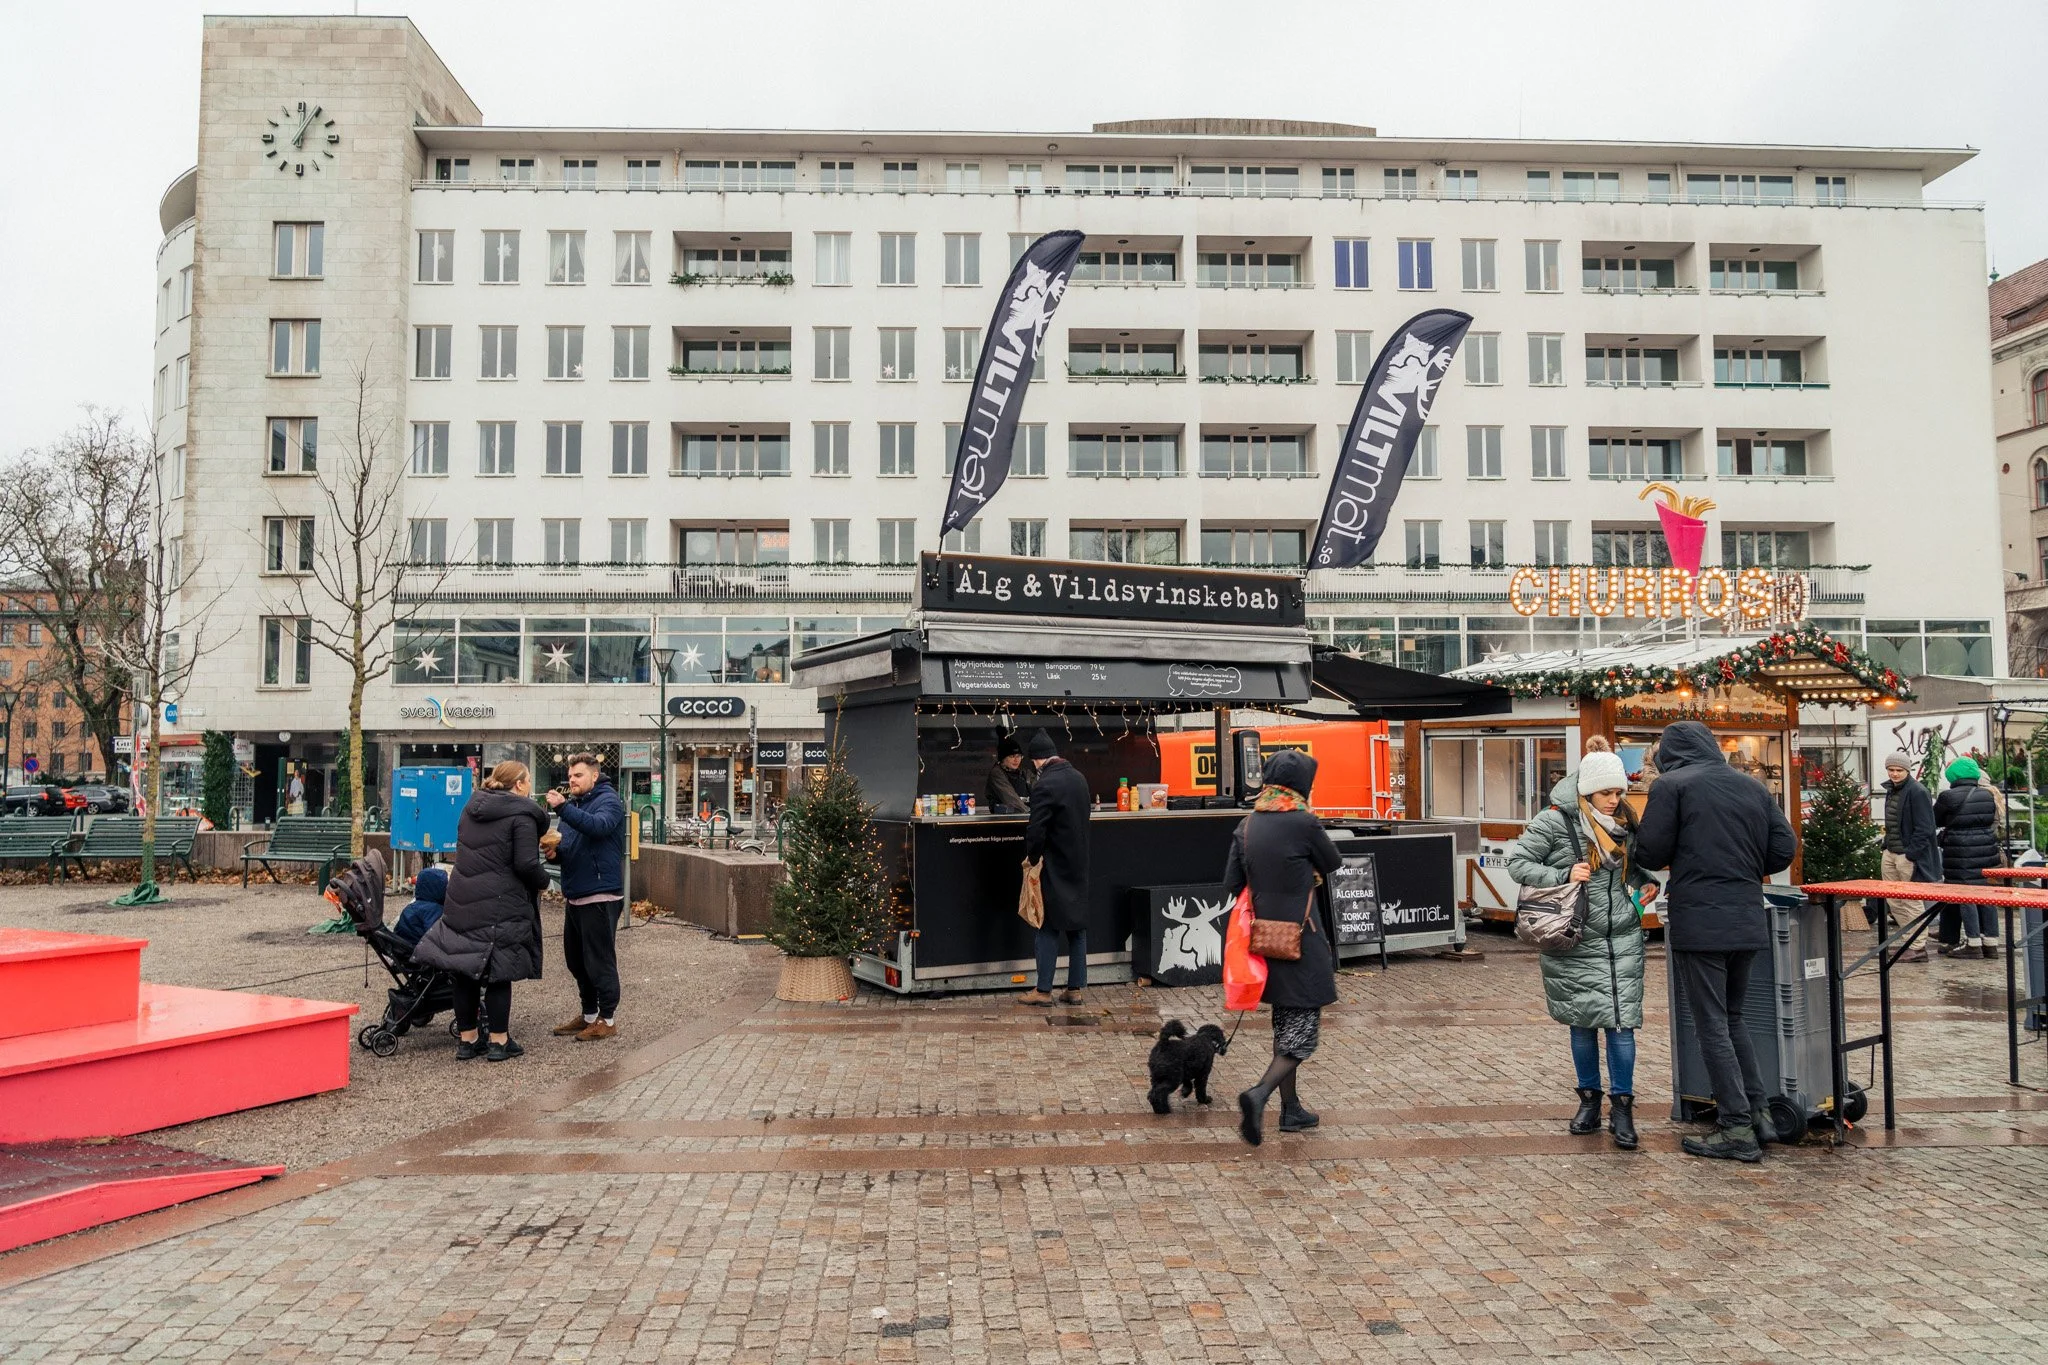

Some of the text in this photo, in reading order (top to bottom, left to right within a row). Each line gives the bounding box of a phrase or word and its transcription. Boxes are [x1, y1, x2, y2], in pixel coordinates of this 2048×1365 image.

[955, 563, 1280, 610] Älg & Vildsvinskebab
[1510, 567, 1775, 618] CHURROS
[1016, 661, 1028, 669] 139
[1028, 661, 1036, 669] kr
[1045, 663, 1082, 671] Barnportion
[1046, 673, 1107, 681] Läsk 25 kr
[956, 680, 1011, 690] Vegetariskkebab
[1018, 681, 1031, 689] 139
[400, 703, 495, 718] svea vaccin
[679, 698, 733, 715] ecco
[760, 749, 785, 758] ecco
[1486, 857, 1502, 867] RYH
[1352, 901, 1358, 910] &
[1342, 911, 1371, 921] TORKAT
[1341, 923, 1375, 933] RENKÖTT
